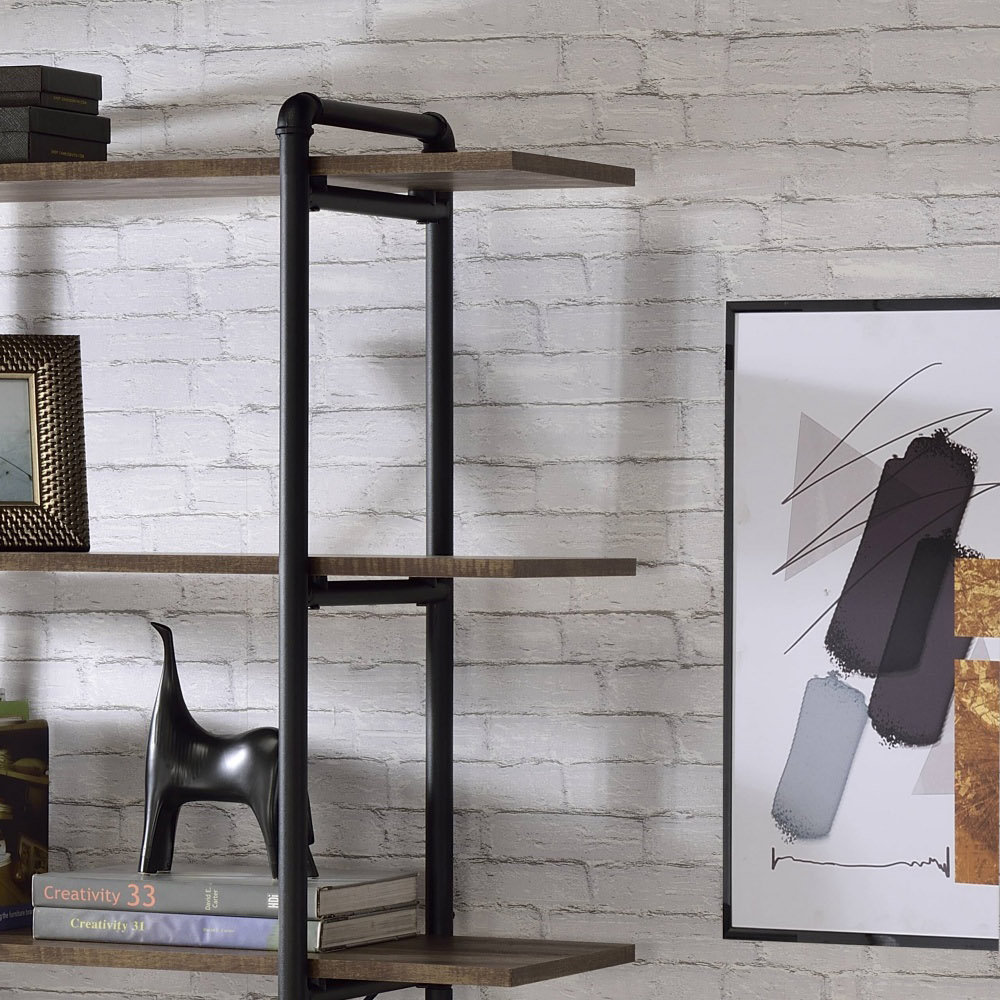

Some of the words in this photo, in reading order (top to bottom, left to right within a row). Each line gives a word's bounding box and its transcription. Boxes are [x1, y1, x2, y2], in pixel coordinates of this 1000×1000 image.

[43, 885, 121, 906] Creativity
[127, 883, 156, 908] 33
[70, 917, 128, 933] Creativity
[131, 920, 145, 932] 31
